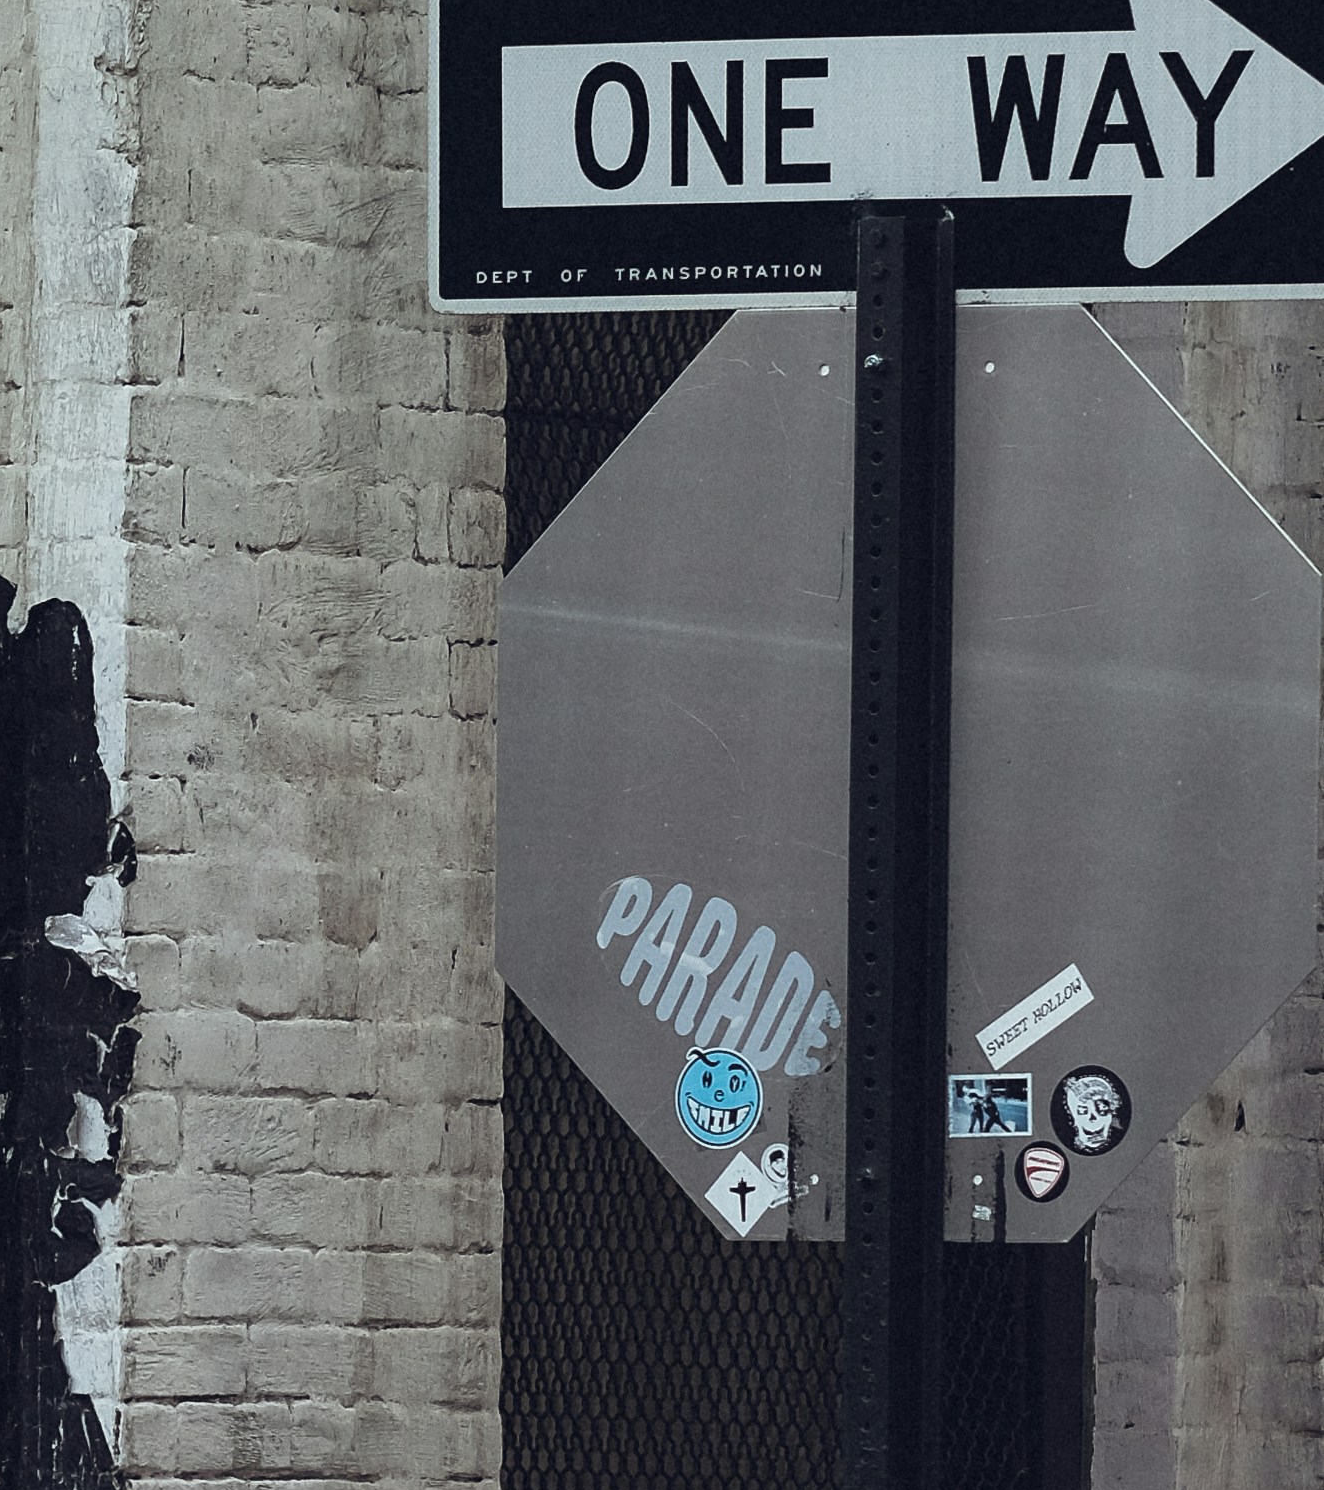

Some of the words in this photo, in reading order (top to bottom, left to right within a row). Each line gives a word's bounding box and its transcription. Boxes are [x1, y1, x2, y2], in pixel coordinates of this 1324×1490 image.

[575, 57, 831, 190] ONE
[967, 49, 1255, 183] WAY
[476, 270, 533, 284] DEPT
[560, 268, 588, 283] OF
[615, 264, 822, 282] TRANSPORTATION
[596, 875, 842, 1077] PARADE
[985, 1017, 1028, 1057] SWEET
[1033, 977, 1082, 1024] HOLLOW
